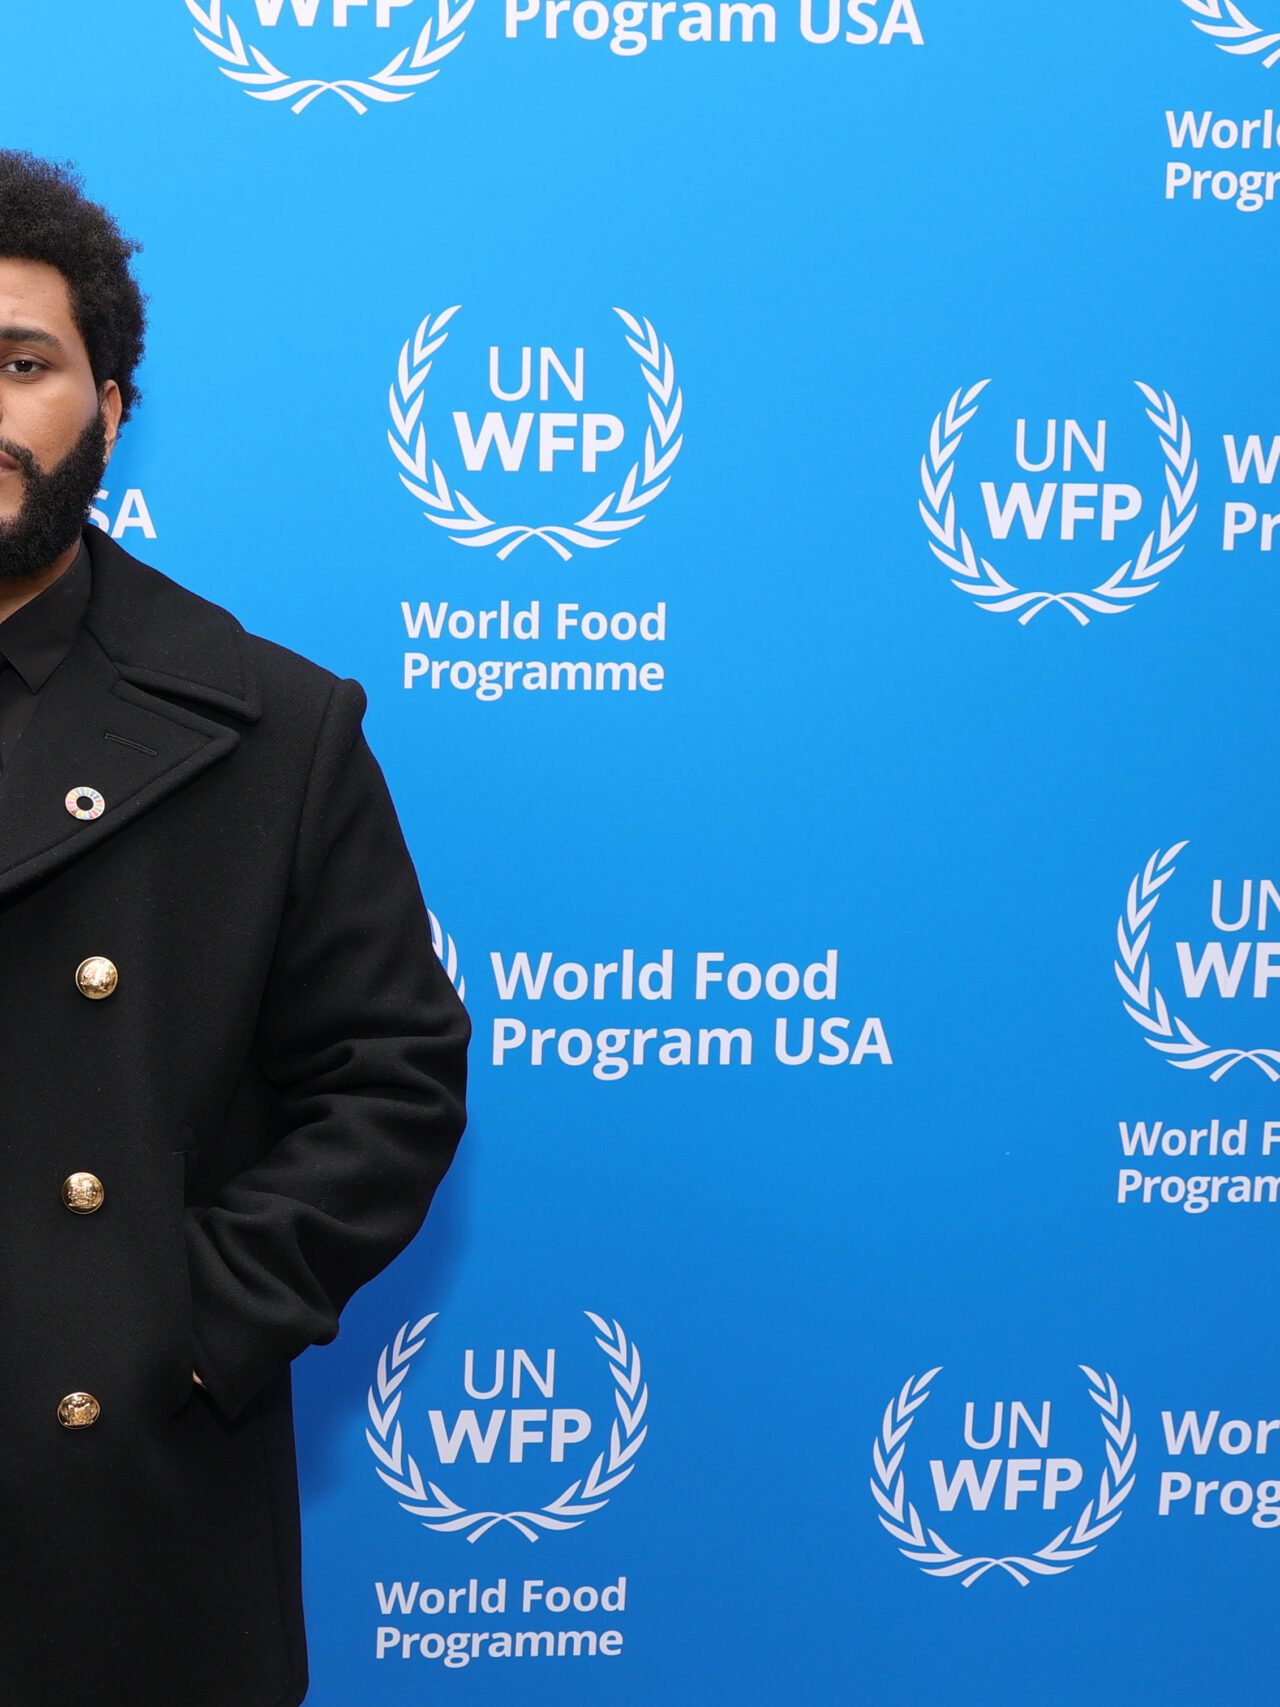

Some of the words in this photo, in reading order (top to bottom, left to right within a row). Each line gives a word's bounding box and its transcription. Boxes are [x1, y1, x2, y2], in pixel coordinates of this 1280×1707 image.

[505, 0, 777, 56] Program
[799, 0, 925, 46] USA
[1165, 108, 1280, 150] Worl
[1165, 161, 1280, 213] Progr
[489, 345, 585, 402] UN
[452, 411, 625, 473] WFP
[1015, 418, 1107, 473] UN
[980, 481, 1143, 541] WFP
[400, 600, 540, 640] World
[557, 601, 667, 641] Food
[403, 652, 665, 702] Programme
[490, 949, 674, 1001] World
[695, 949, 838, 1001] Food
[1175, 941, 1280, 998] WF
[492, 1017, 753, 1081] Program
[774, 1017, 893, 1066] USA
[1118, 1119, 1248, 1156] World
[1117, 1169, 1280, 1214] Program
[464, 1348, 556, 1400] UN
[428, 1408, 592, 1464] WFP
[964, 1400, 1051, 1450] UN
[1161, 1410, 1280, 1455] Wor
[929, 1458, 1083, 1512] WFP
[1158, 1471, 1280, 1529] Prog
[375, 1578, 507, 1615] World
[522, 1576, 627, 1613] Food
[376, 1626, 624, 1668] Programme
